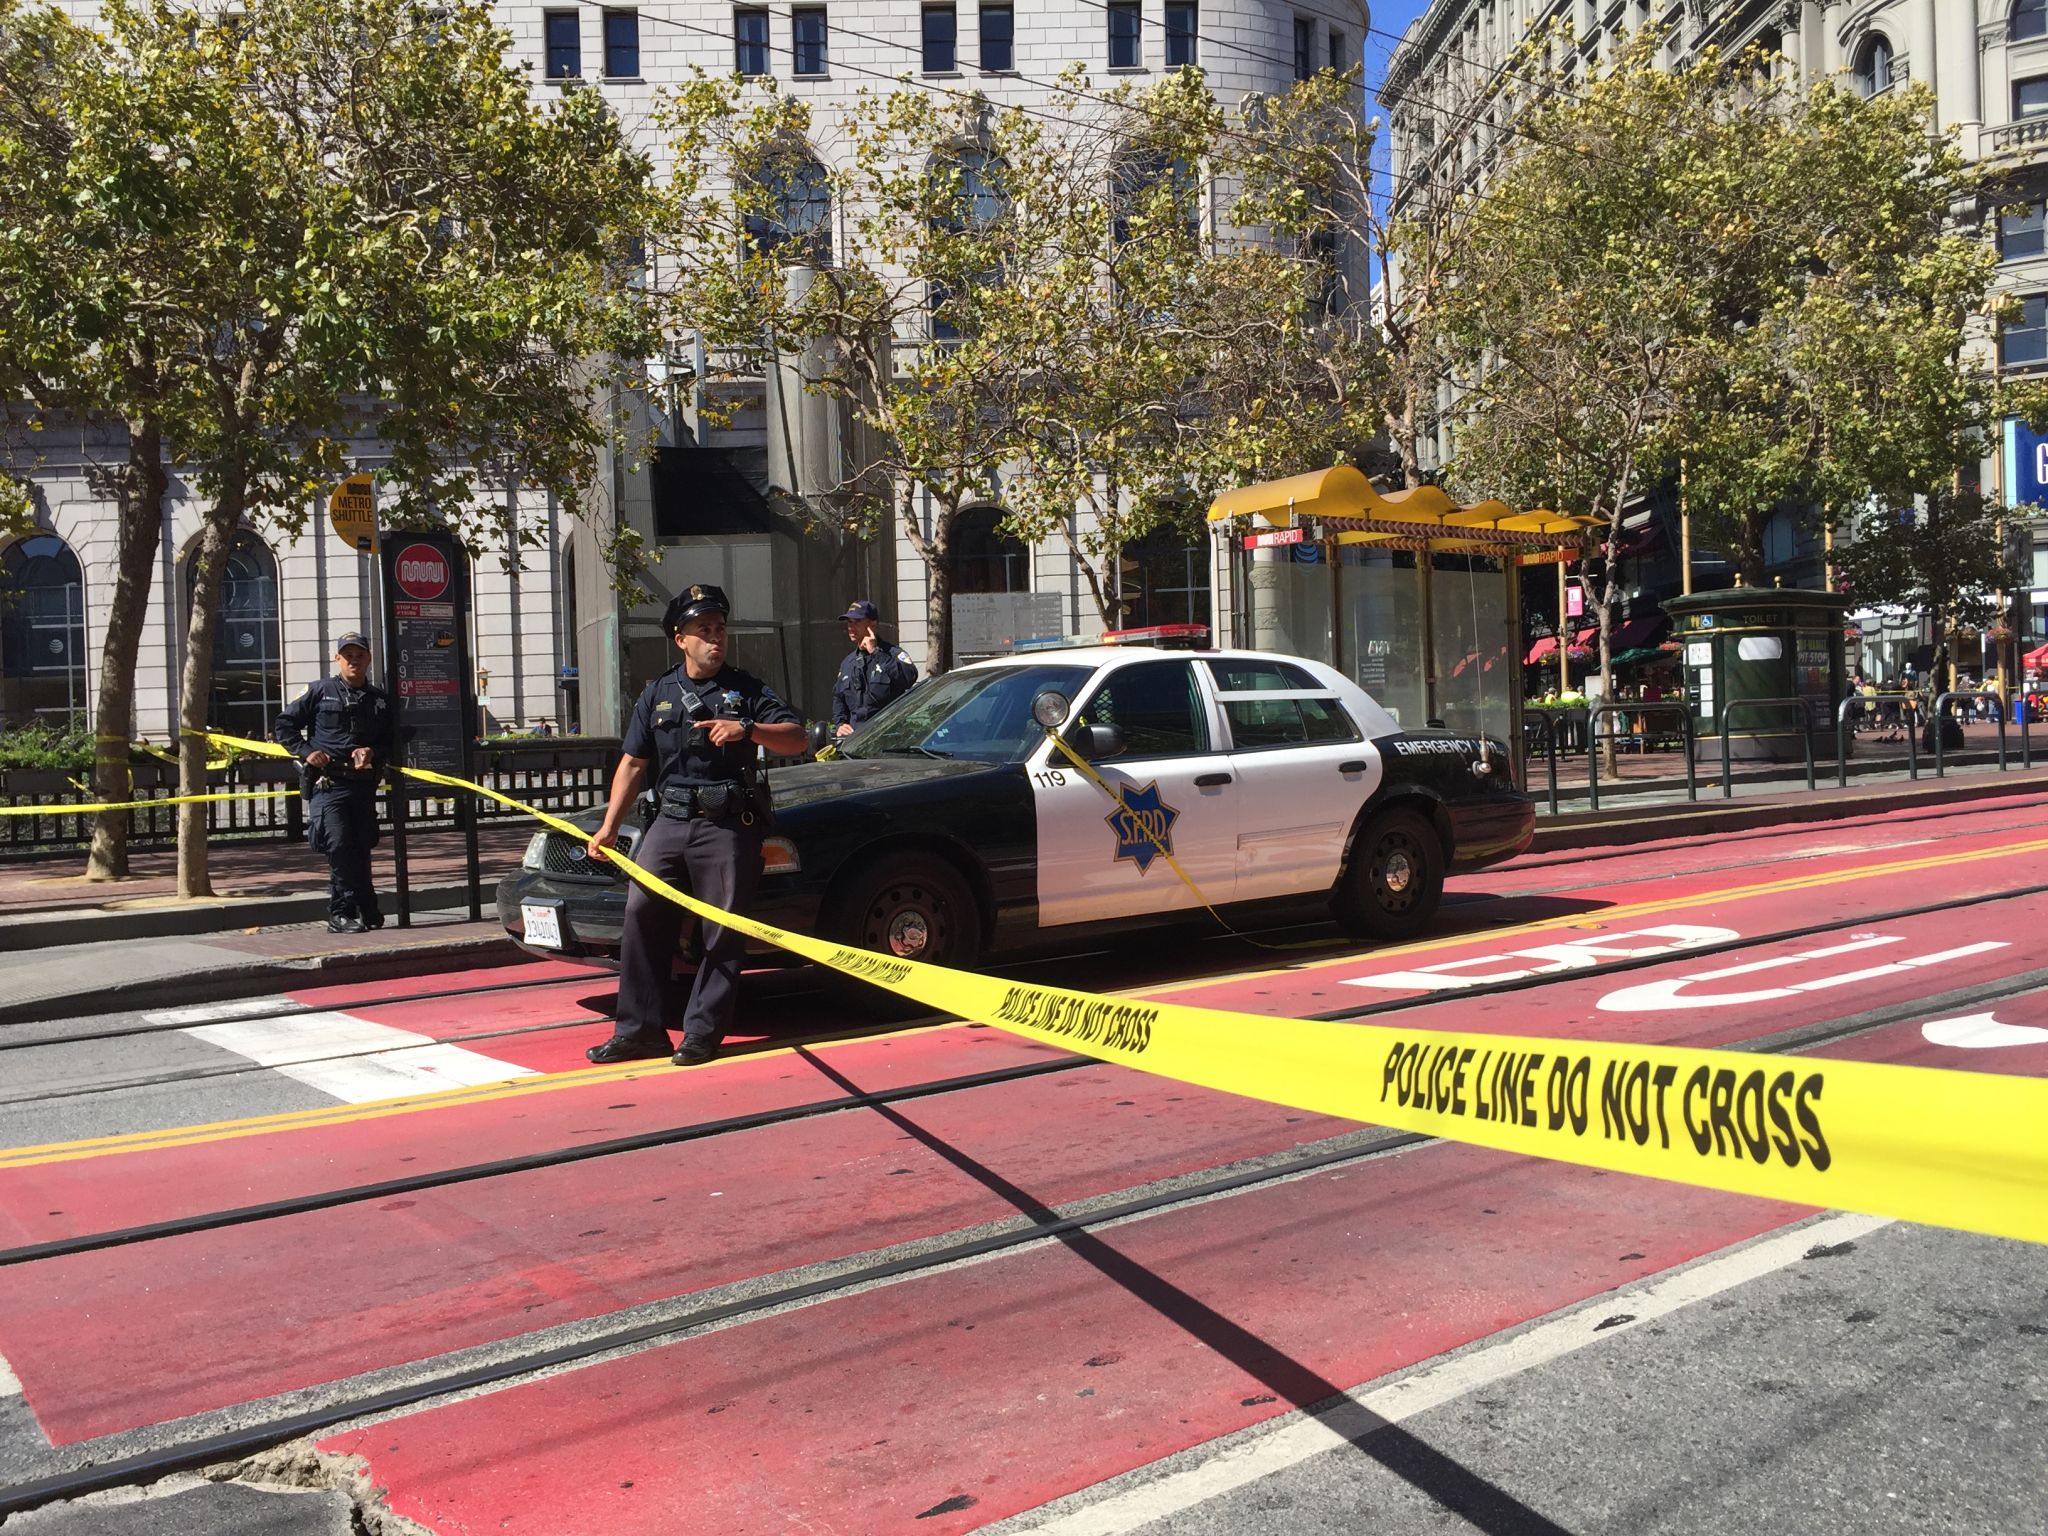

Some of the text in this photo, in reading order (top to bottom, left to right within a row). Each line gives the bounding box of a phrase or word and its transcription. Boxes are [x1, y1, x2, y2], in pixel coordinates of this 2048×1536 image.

[338, 496, 372, 509] METRO
[332, 509, 372, 522] SHUTTLE
[1273, 529, 1298, 545] RAPID
[1540, 551, 1564, 563] RAPID
[1742, 614, 1778, 624] TOILET
[398, 620, 408, 635] F
[401, 649, 409, 662] 6
[399, 665, 407, 679] 9
[400, 696, 409, 710] 7
[1393, 740, 1473, 756] EMERGENCY
[407, 757, 416, 769] N
[1033, 770, 1066, 788] 119
[991, 987, 1159, 1054] POLICE LINE DO NOT CROSS
[1381, 1042, 1832, 1172] POLICE LINE DO NOT CROSS
